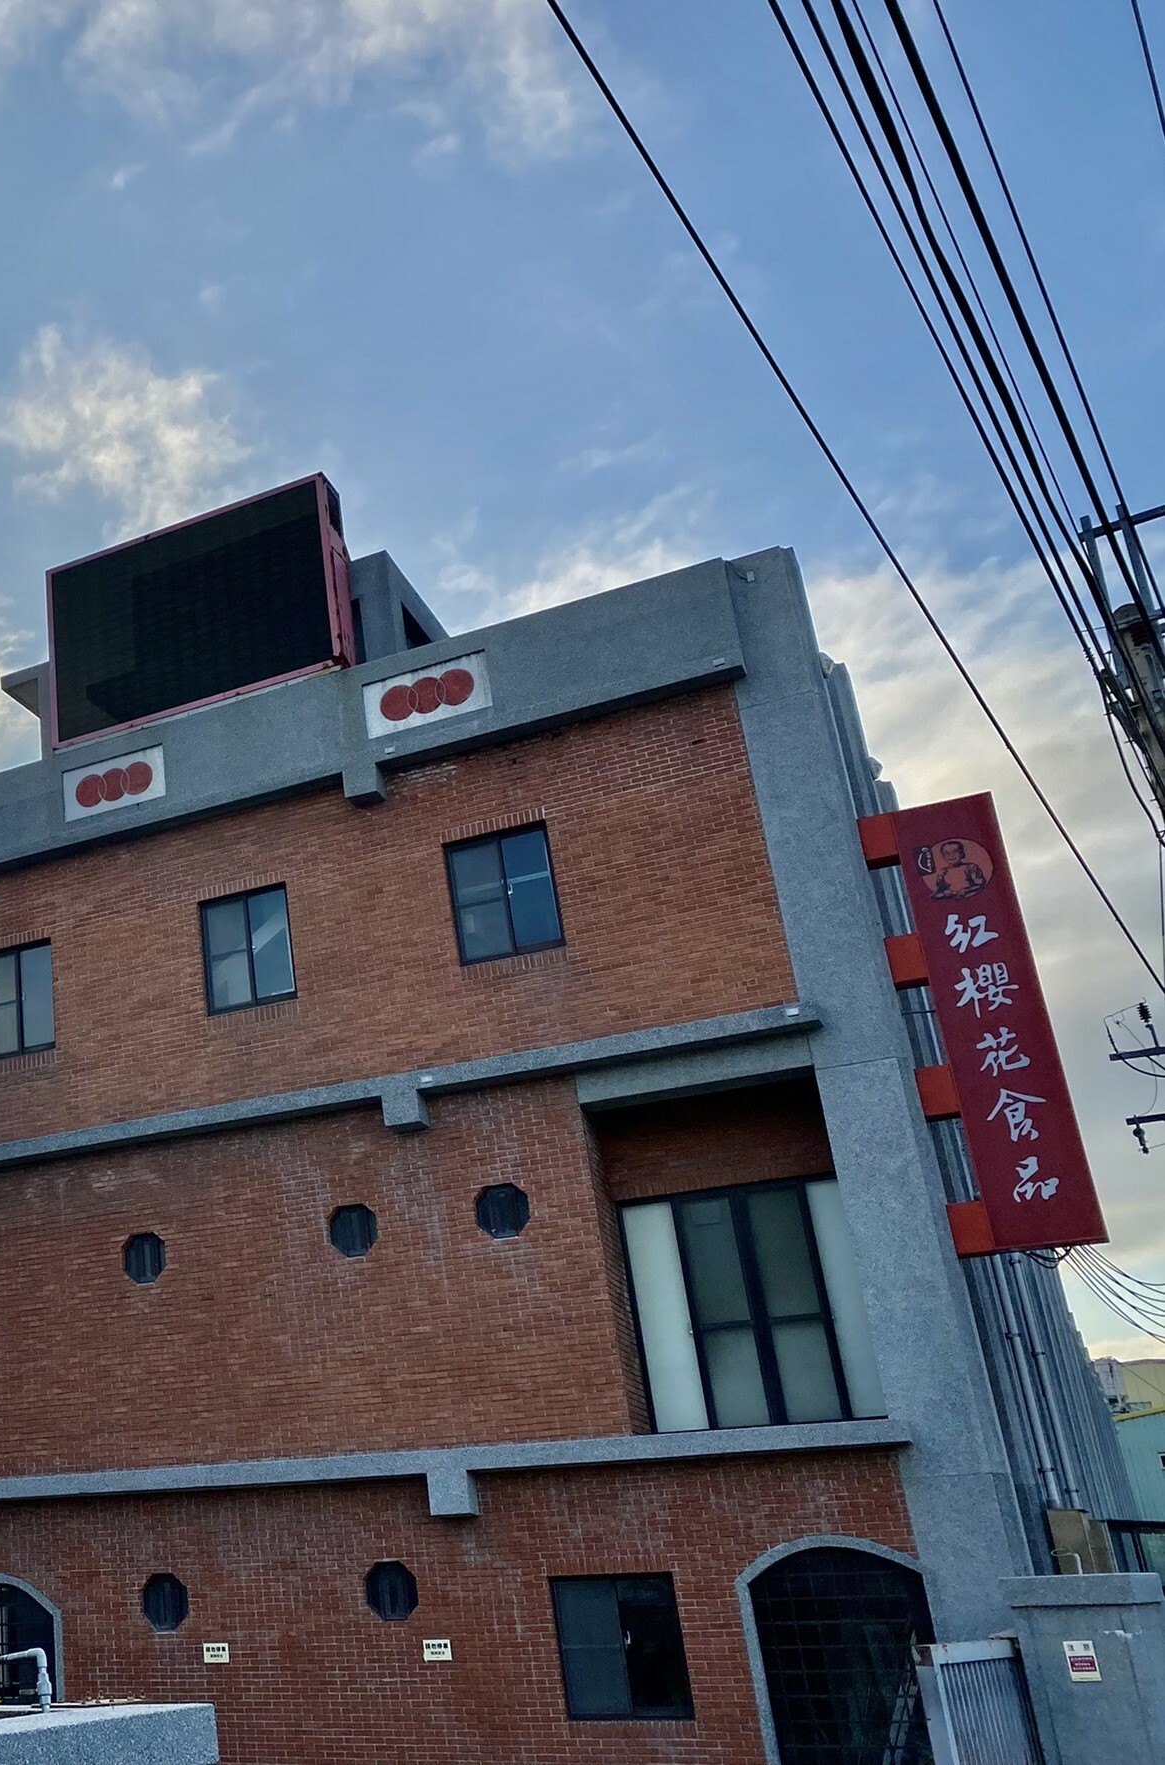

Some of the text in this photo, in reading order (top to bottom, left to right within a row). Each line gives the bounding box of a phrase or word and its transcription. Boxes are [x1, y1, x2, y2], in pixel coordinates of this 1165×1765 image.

[944, 913, 1060, 1203] 紅櫻花食品
